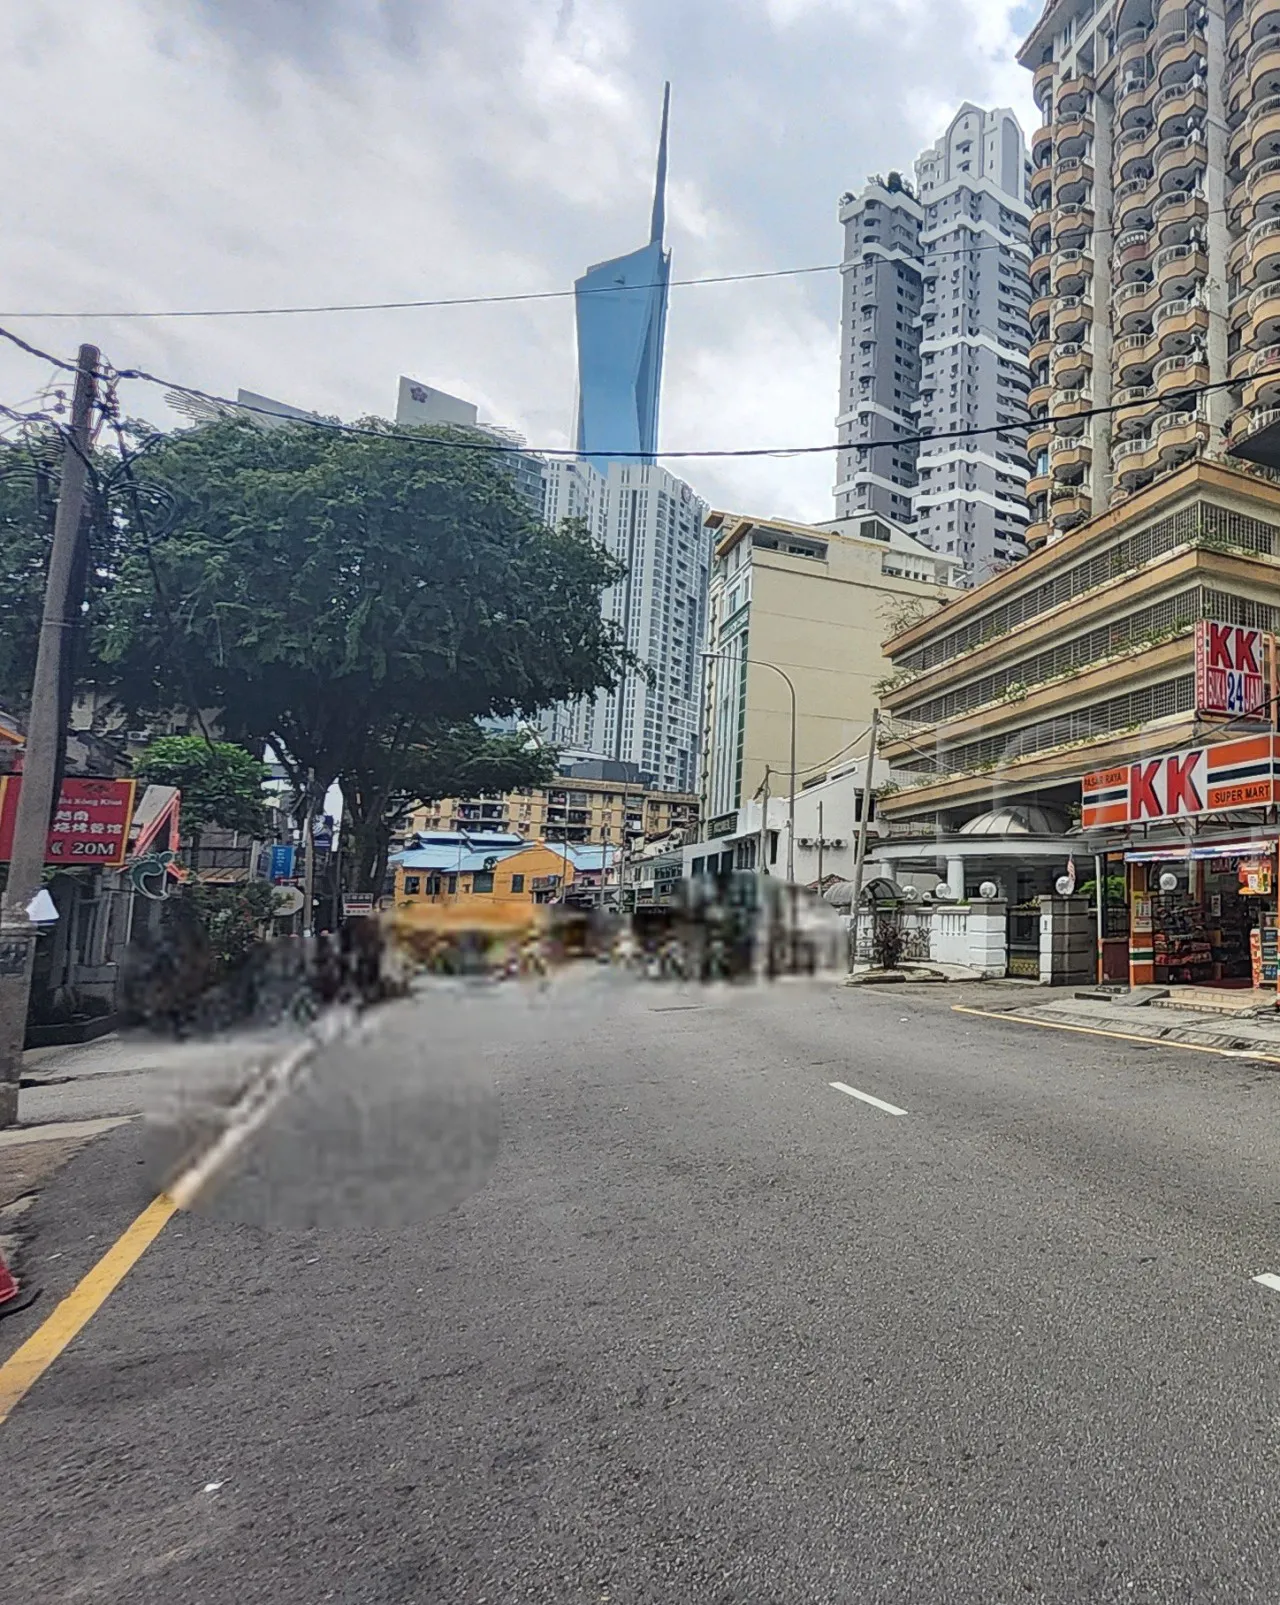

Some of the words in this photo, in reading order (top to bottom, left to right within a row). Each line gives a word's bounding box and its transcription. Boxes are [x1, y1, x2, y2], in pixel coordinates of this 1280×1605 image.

[1210, 623, 1260, 674] KK
[1227, 671, 1244, 713] 24
[1083, 776, 1104, 788] PASAR
[1105, 772, 1122, 784] RAYA
[1130, 749, 1205, 821] KK
[1214, 789, 1243, 804] SUPER
[1245, 784, 1271, 799] MART
[72, 842, 115, 855] 20M
